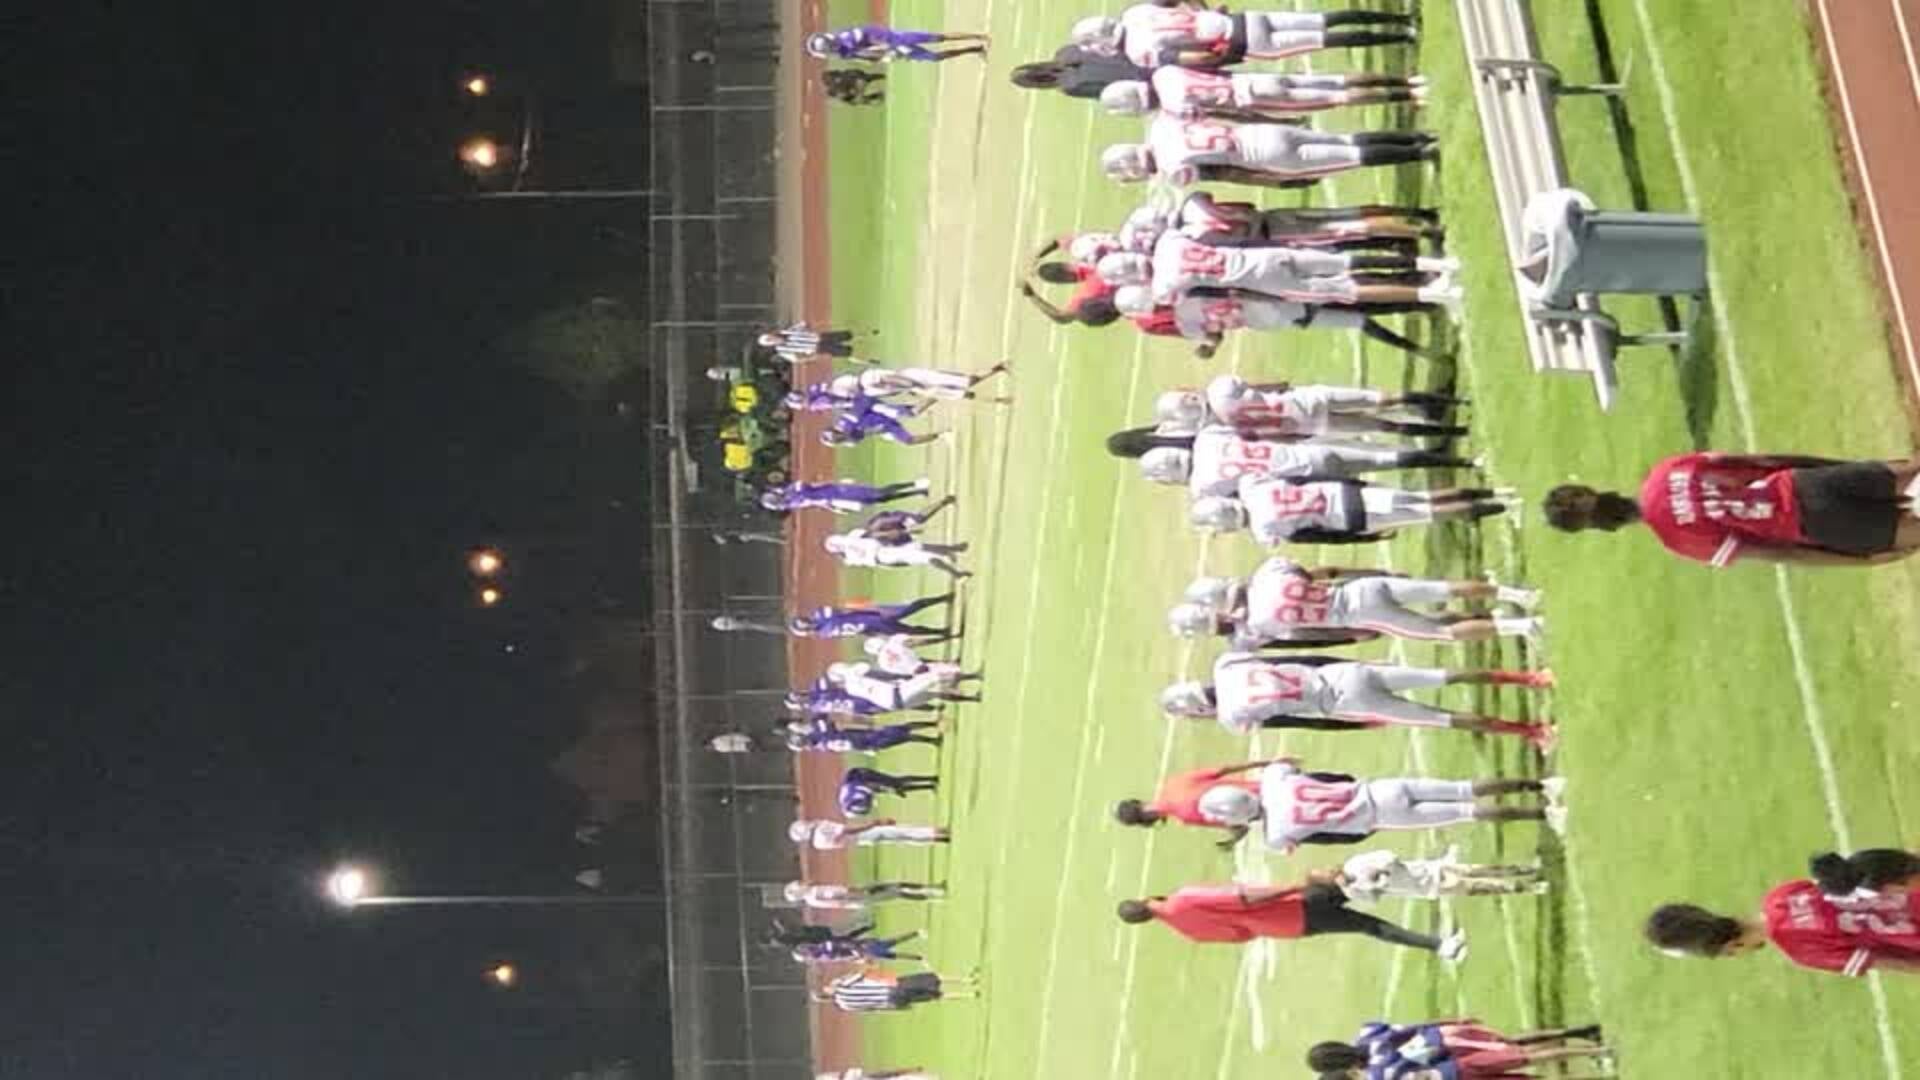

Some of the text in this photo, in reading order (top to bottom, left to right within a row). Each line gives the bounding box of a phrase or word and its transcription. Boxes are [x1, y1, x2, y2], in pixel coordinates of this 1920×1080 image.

[1180, 247, 1226, 279] 19
[1272, 487, 1328, 518] 15
[1275, 580, 1330, 624] 28
[1247, 669, 1304, 704] 17
[1292, 783, 1356, 826] 50
